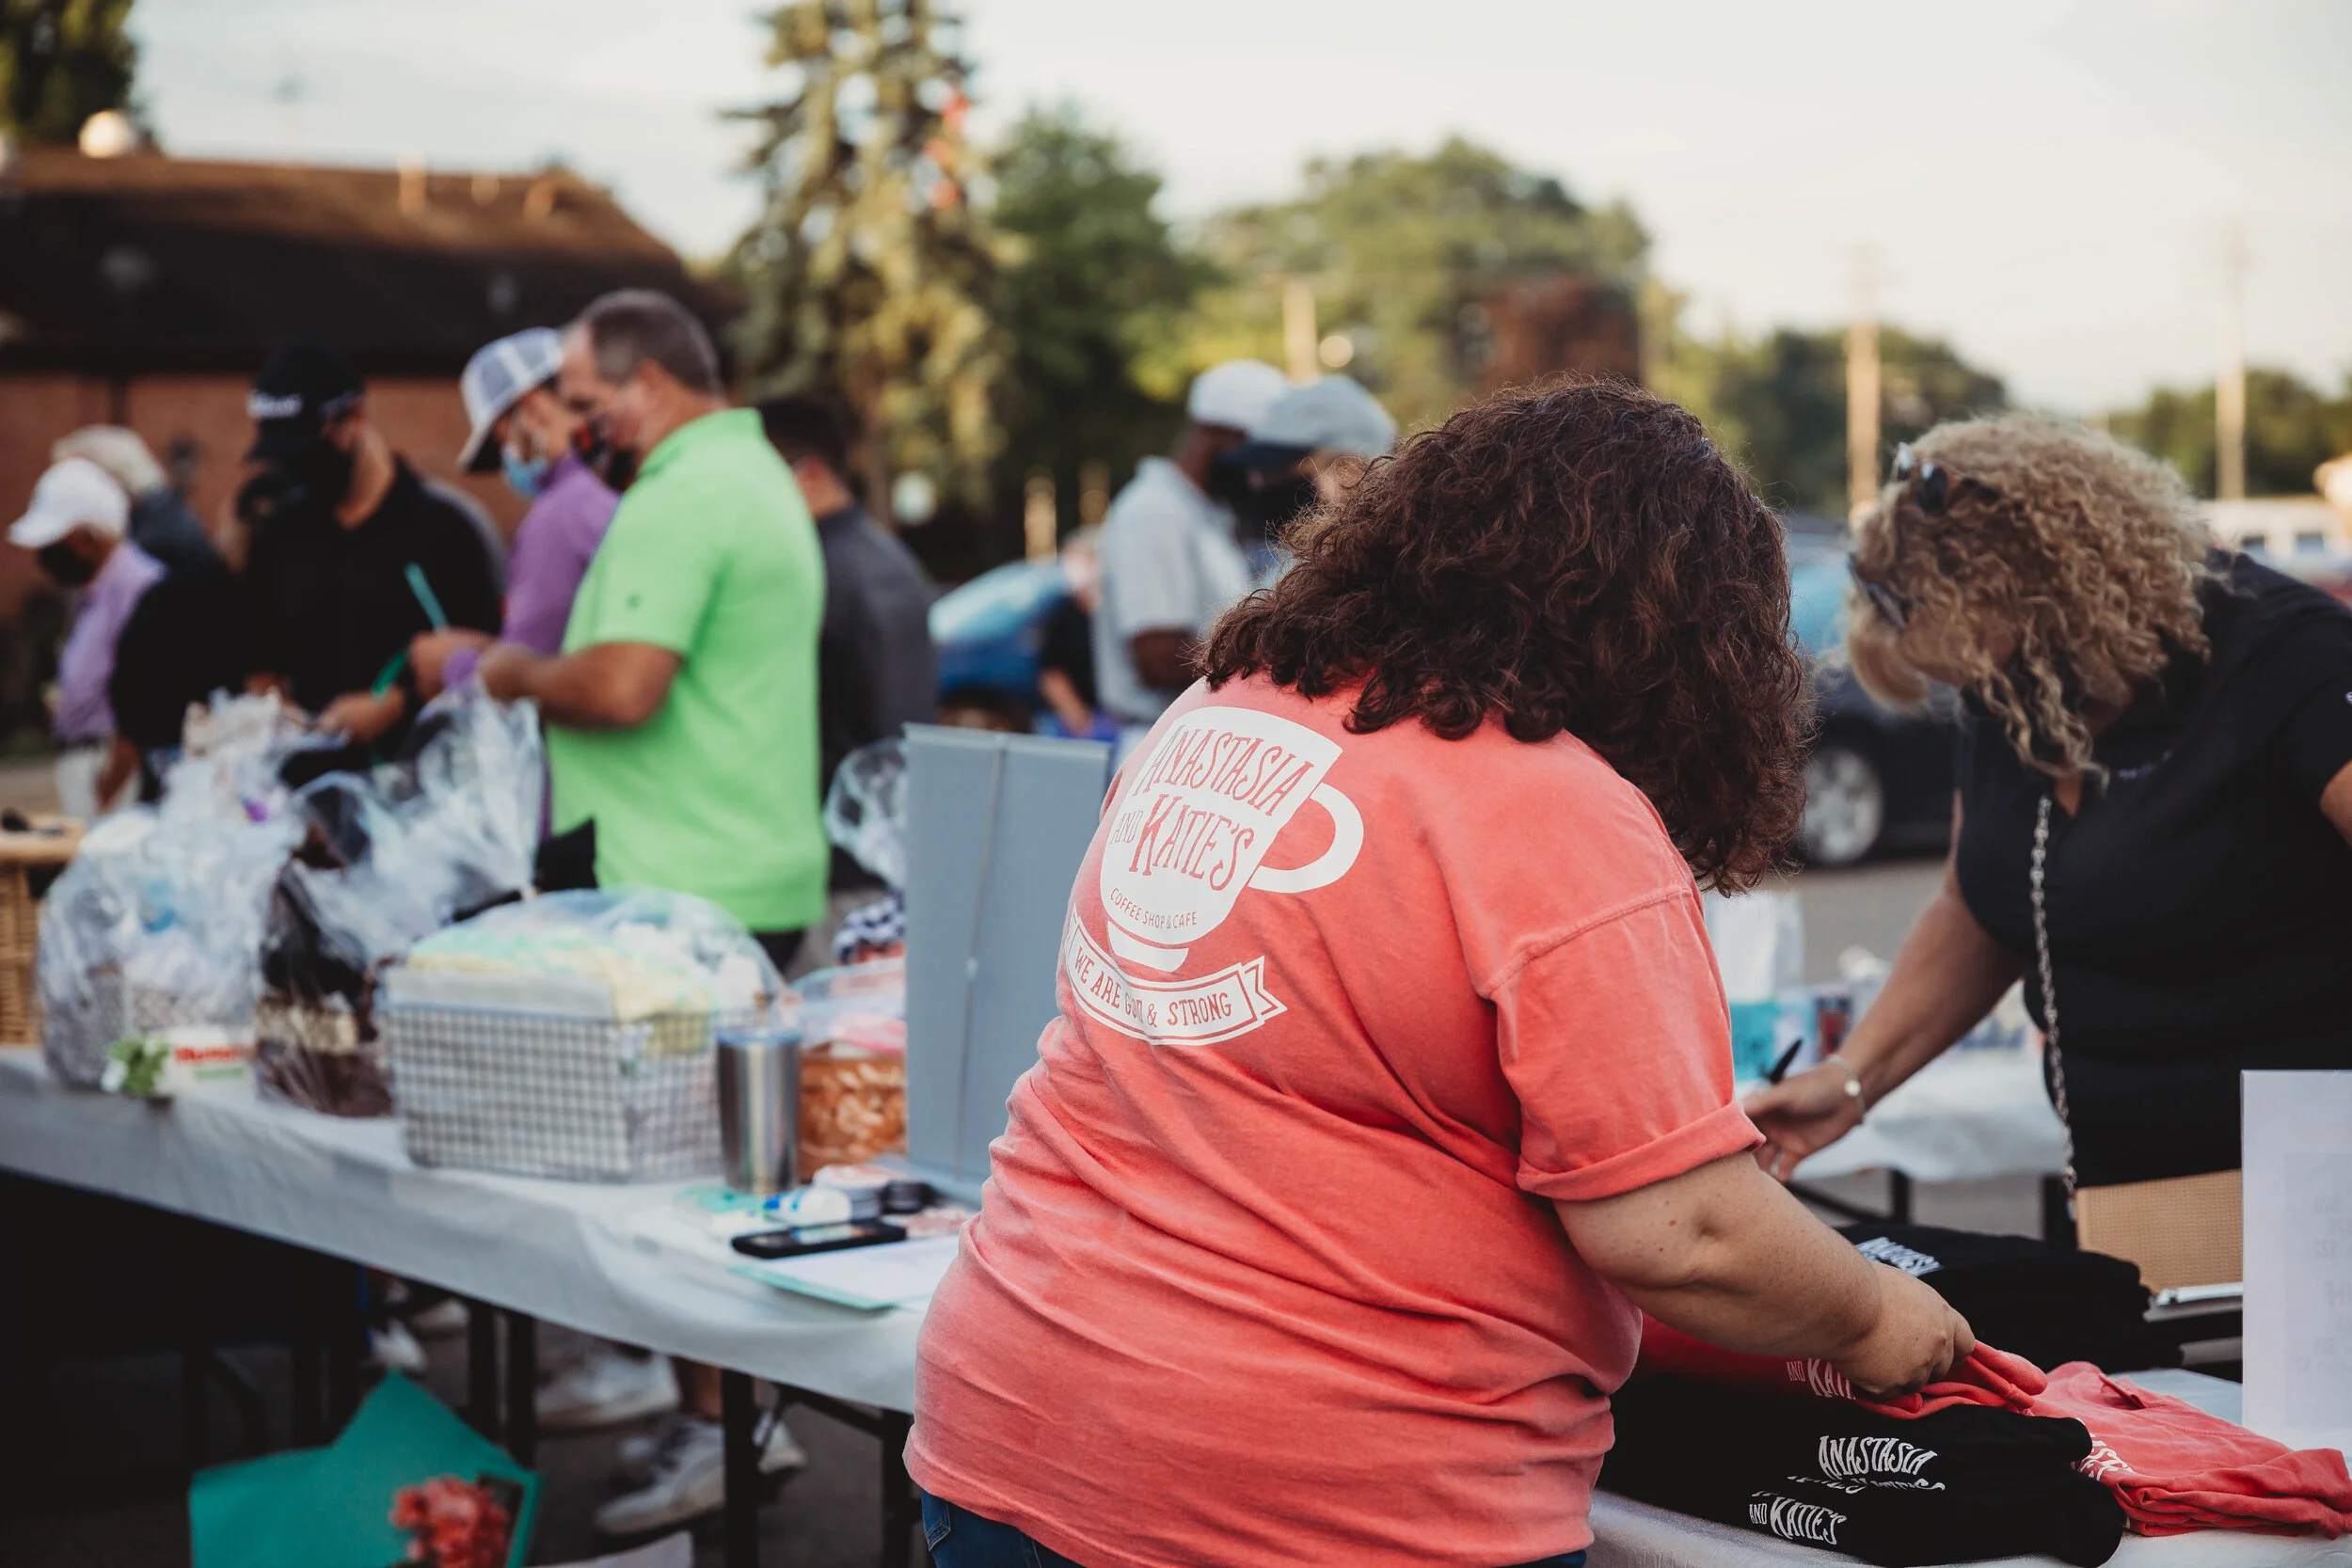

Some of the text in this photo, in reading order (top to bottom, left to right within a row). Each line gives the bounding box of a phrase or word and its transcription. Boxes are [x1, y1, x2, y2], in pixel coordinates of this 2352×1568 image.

[1132, 724, 1314, 816] ANASTASIA
[1110, 794, 1254, 891] AND KATIE'S
[1110, 888, 1141, 921] COFFEE
[1074, 946, 1095, 984] WE
[1090, 971, 1121, 1008] ARE
[1147, 1003, 1157, 1028] &
[1167, 992, 1232, 1026] STRONG
[1787, 1361, 1805, 1382] AND
[1819, 1435, 1937, 1480] ANASTASIA
[1749, 1497, 1847, 1544] AND KATIE'S
